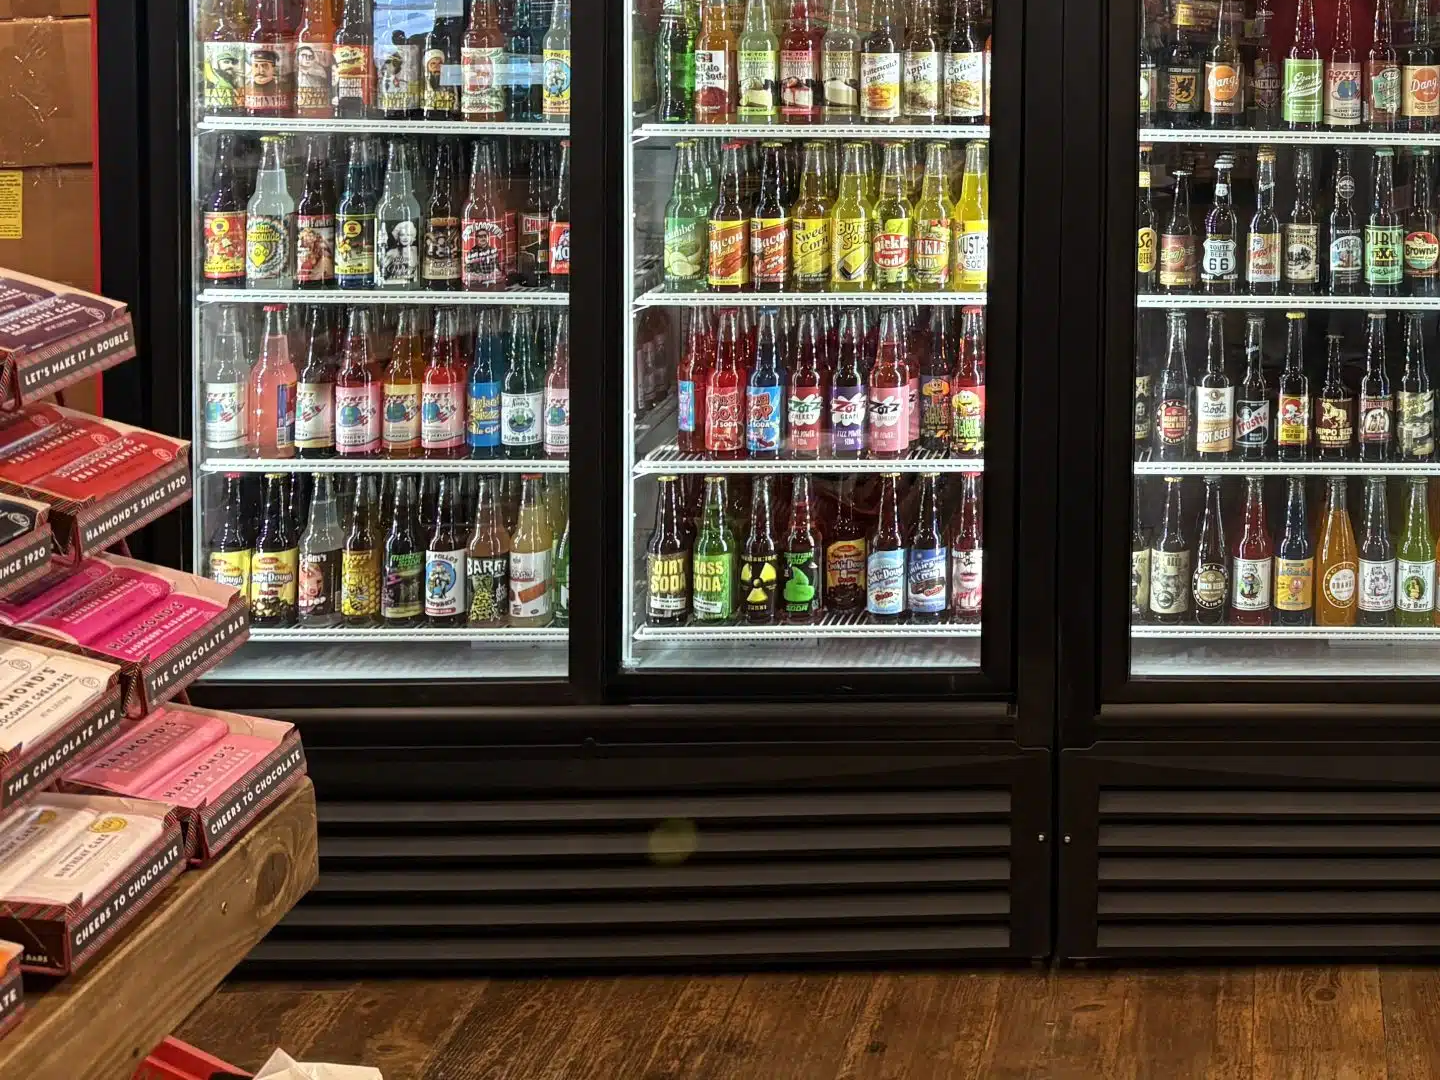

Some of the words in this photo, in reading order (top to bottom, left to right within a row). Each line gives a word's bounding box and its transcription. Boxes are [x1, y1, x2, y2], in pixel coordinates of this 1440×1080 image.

[906, 61, 932, 77] Apple
[912, 72, 928, 84] Pie
[1410, 78, 1440, 92] Dang!
[709, 231, 744, 253] Bacon
[754, 229, 790, 249] Bacon
[795, 223, 828, 245] Sweet
[799, 234, 829, 253] Corn
[1405, 244, 1438, 257] Brownie
[1209, 258, 1230, 270] 66
[25, 367, 51, 386] LET'S
[52, 354, 77, 374] MAKE
[78, 351, 87, 362] IT
[89, 348, 95, 357] A
[97, 331, 129, 353] DOUBLE
[1236, 410, 1269, 434] Frostie
[1316, 427, 1338, 435] HIPPO
[1214, 428, 1233, 441] BEER
[99, 443, 148, 469] SANDWICH
[86, 503, 139, 542] HAMMOND'S
[141, 487, 165, 509] SINCE
[167, 475, 188, 494] 1920
[24, 547, 46, 566] 1920
[467, 559, 507, 576] BARF!
[654, 559, 685, 575] DIRT
[693, 560, 724, 574] RASS
[651, 575, 686, 593] SODA
[1413, 600, 1430, 609] Barf
[107, 601, 185, 651] HAMMOND'S
[151, 672, 170, 691] THE
[172, 631, 226, 676] CHOCOLATE
[228, 617, 245, 635] BAR
[8, 775, 28, 796] THE
[33, 725, 93, 778] CHOCOLATE
[97, 709, 116, 729] BAR
[96, 720, 176, 768] HAMMOND'S
[163, 744, 235, 798] HAMMOND'S
[211, 803, 242, 835] CHEERS
[242, 791, 254, 808] TO
[255, 750, 301, 790] CHOCOLATE
[75, 907, 111, 946] CHEERS
[113, 894, 126, 911] TO
[128, 845, 179, 898] CHOCOLATE
